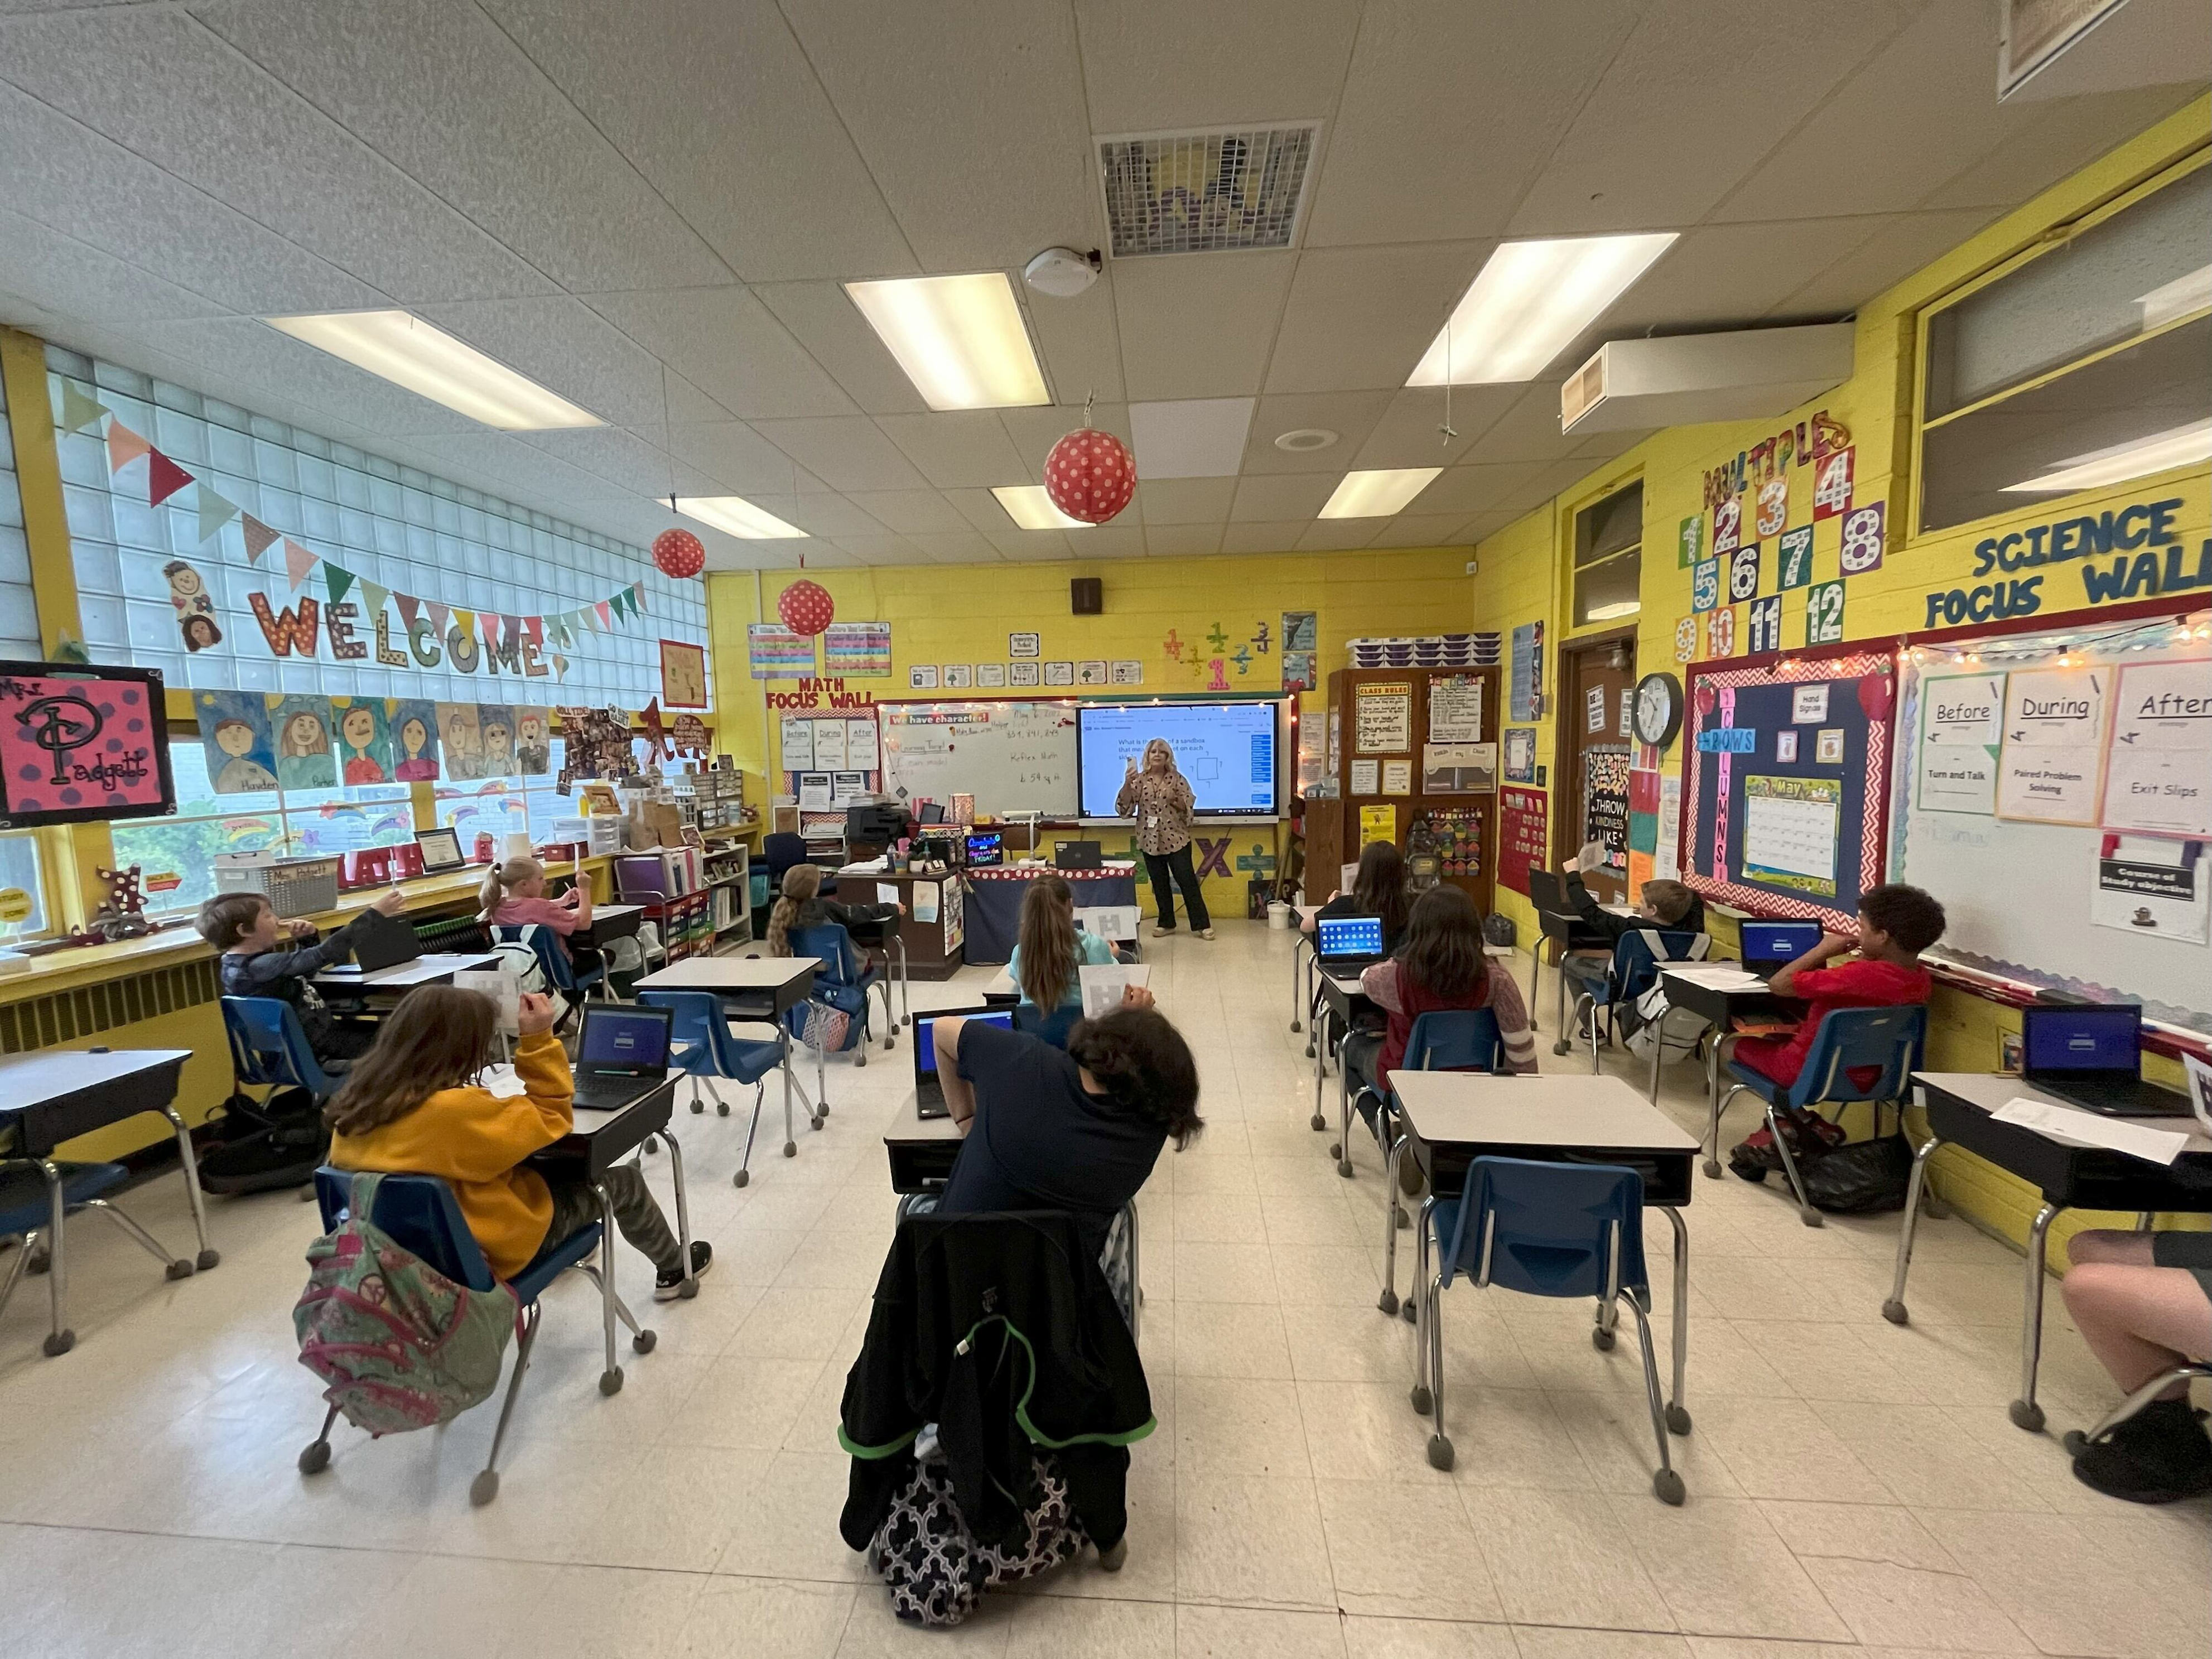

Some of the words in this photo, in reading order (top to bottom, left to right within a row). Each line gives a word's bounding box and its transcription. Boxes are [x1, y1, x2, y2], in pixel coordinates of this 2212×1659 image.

[1703, 409, 1851, 510] MULTIPLES
[1815, 451, 1851, 512] 4
[1757, 481, 1786, 536] 3
[1683, 518, 1700, 563] 1
[1714, 501, 1739, 553] 2
[1842, 509, 1881, 571] 8
[1973, 498, 2185, 577] SCIENCE
[1781, 528, 1810, 586] 7
[1695, 561, 1718, 609] 5
[1731, 548, 1757, 599] 6
[1808, 584, 1843, 643] 12
[1924, 576, 2044, 628] FOCUS
[248, 592, 548, 677] WELCOME
[1709, 609, 1733, 658] 10
[1751, 598, 1780, 651] 11
[1675, 618, 1697, 662] 9
[799, 678, 844, 692] MATH
[1207, 658, 1230, 690] 1
[766, 692, 818, 709] FOCUS
[829, 692, 875, 708] WALL
[1937, 703, 1990, 720] Before
[2022, 697, 2090, 718] During
[2139, 693, 2212, 715] After
[909, 715, 933, 724] have
[936, 713, 986, 724] character!
[1712, 730, 1753, 751] ROWS
[242, 780, 279, 792] Hayden
[1776, 780, 1801, 797] May
[1928, 770, 1946, 779] Turn
[1967, 771, 1986, 780] Talk
[2014, 769, 2041, 779] Paired
[2043, 771, 2083, 781] Problem
[2028, 783, 2062, 795] Solving
[2132, 783, 2158, 795] Exit
[2164, 785, 2198, 797] Slips
[1595, 799, 1625, 816] THROW
[1596, 816, 1624, 829] KINDNESS
[2101, 876, 2135, 888] Study
[2118, 868, 2161, 879] Course
